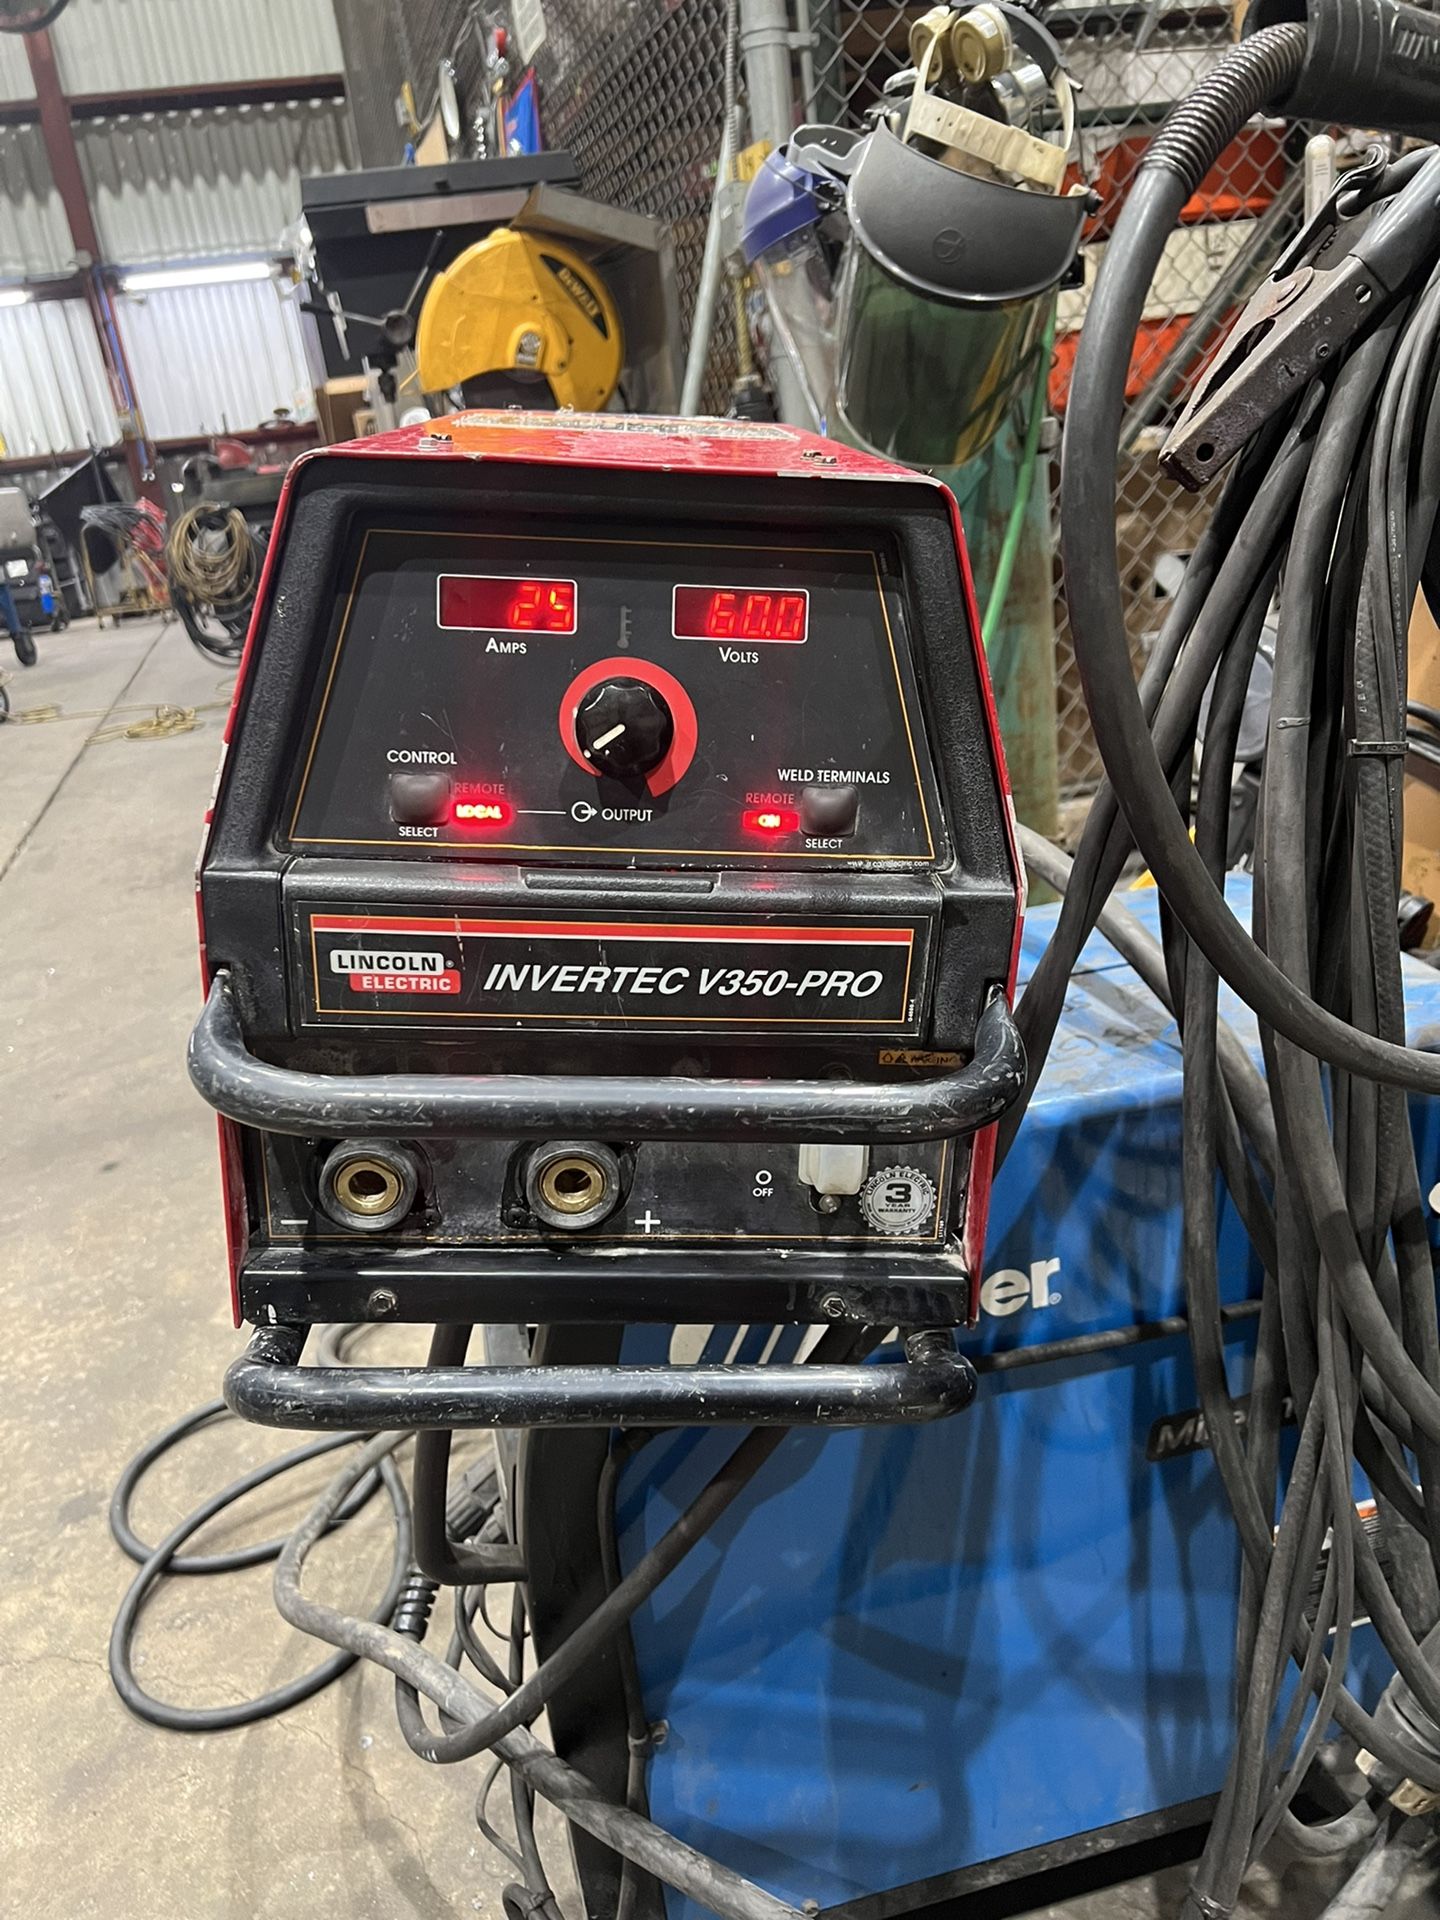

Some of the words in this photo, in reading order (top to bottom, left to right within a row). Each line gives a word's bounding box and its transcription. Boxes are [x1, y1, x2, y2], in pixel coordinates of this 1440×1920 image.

[511, 584, 571, 628] 25
[711, 592, 804, 638] 60.0
[386, 749, 458, 765] CONTROL
[777, 768, 814, 782] WELD
[816, 769, 891, 785] TERMINALS
[453, 782, 506, 795] REMOTE
[745, 792, 795, 805] REMOTE
[455, 803, 503, 819] LOCAL
[601, 807, 653, 822] OUTPUT
[757, 813, 781, 828] ON
[398, 826, 439, 838] SELECT
[804, 838, 843, 849] SELECT
[337, 954, 438, 972] LINCOLN
[361, 974, 452, 992] ELECTRIC
[483, 963, 690, 996] INVERTEC
[698, 967, 884, 998] V350-PRO
[752, 1187, 774, 1197] OFF
[885, 1183, 912, 1203] 3
